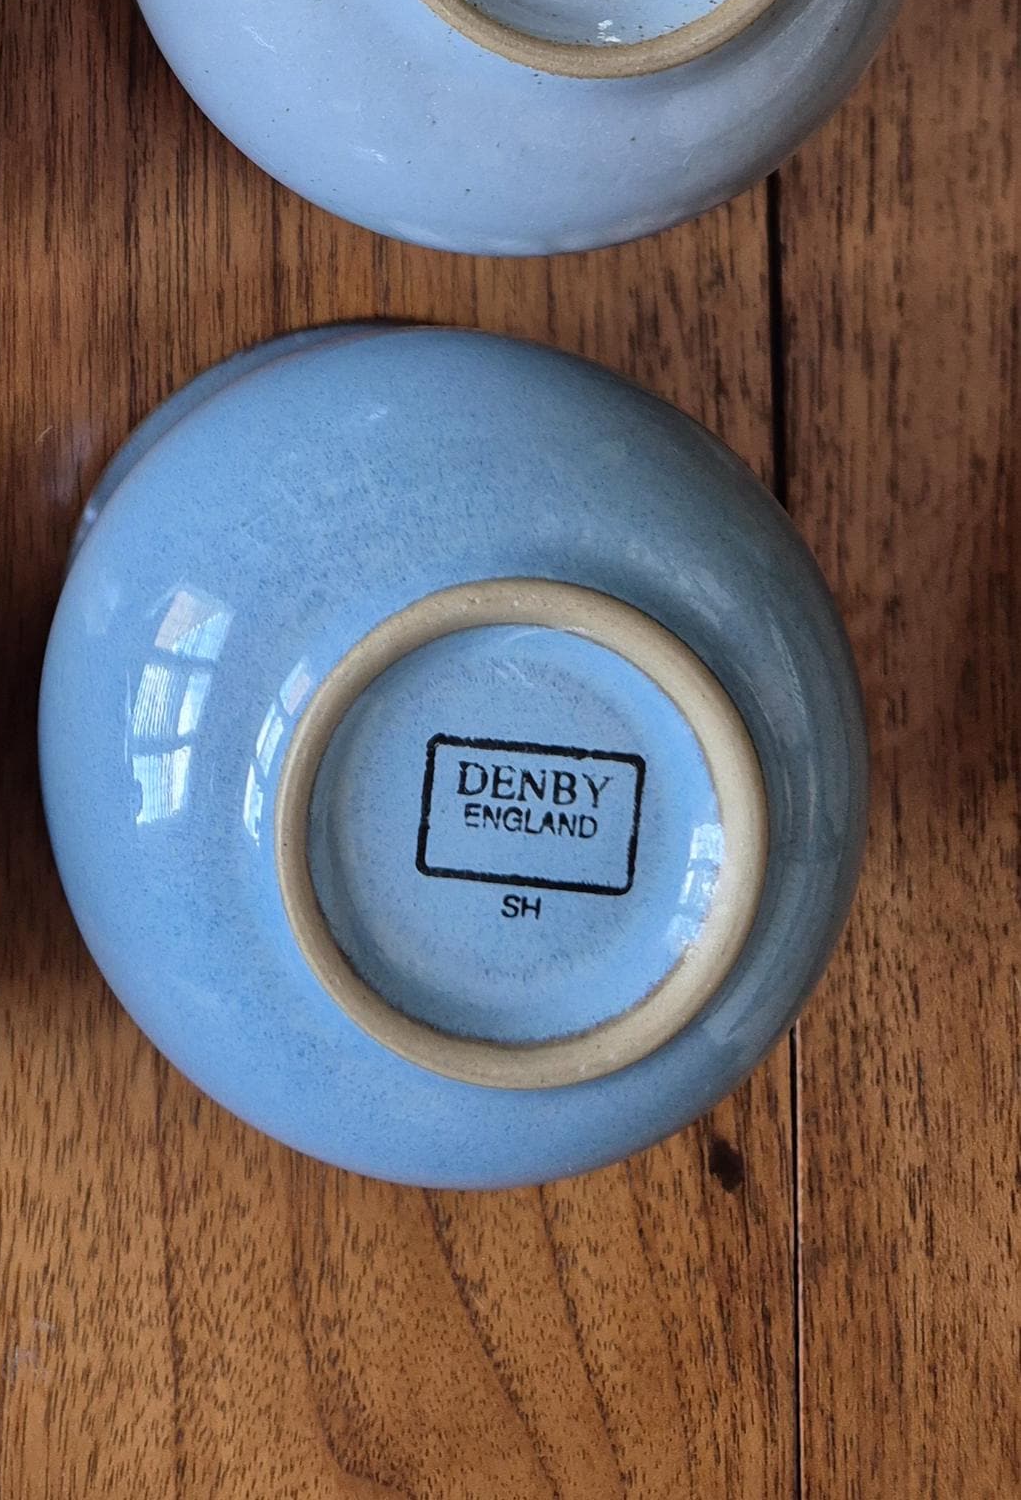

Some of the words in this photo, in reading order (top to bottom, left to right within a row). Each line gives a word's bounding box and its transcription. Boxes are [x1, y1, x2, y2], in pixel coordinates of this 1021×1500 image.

[456, 761, 614, 809] DENBY
[464, 803, 599, 839] ENGLAND
[501, 894, 542, 920] SH
